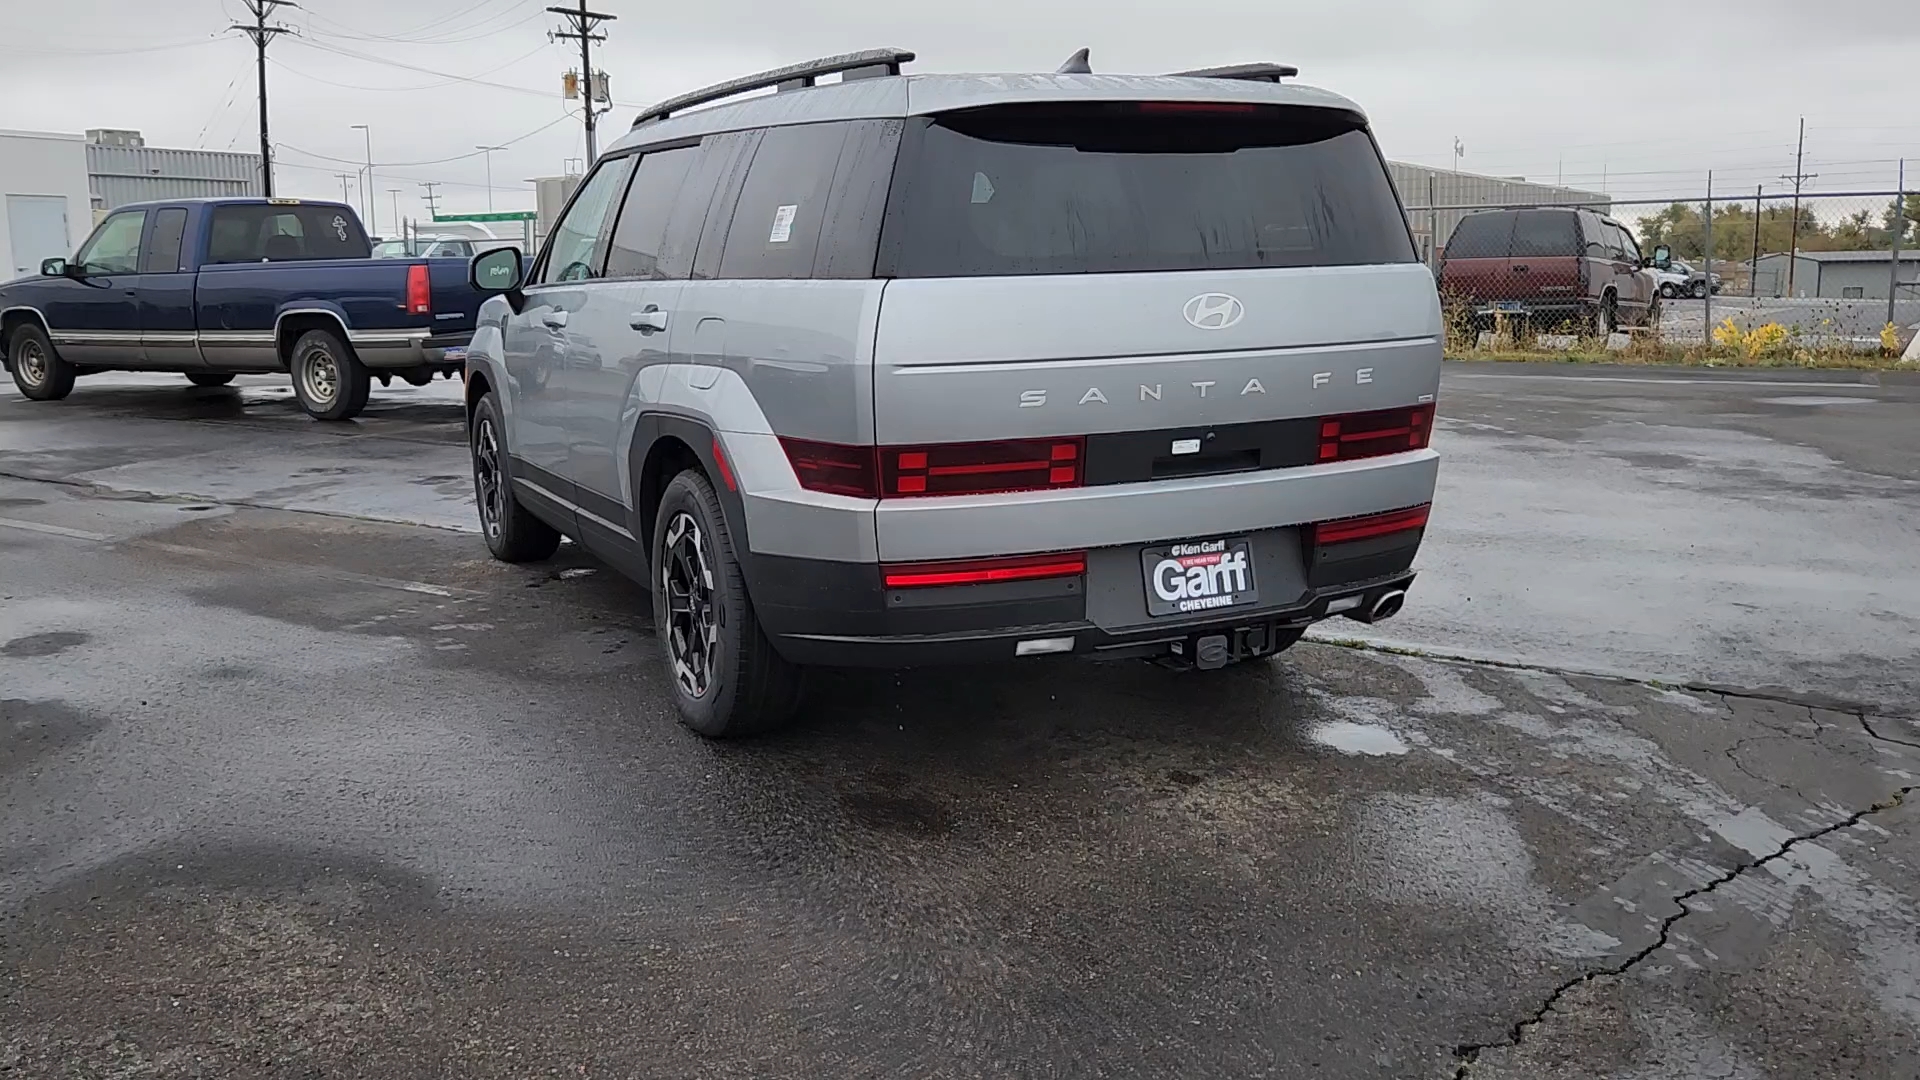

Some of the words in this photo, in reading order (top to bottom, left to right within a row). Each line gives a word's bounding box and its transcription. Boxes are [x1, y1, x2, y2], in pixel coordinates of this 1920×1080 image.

[1019, 379, 1267, 408] SANTA
[1312, 367, 1374, 389] FE
[1180, 543, 1200, 556] Ken
[1201, 540, 1225, 553] Garff
[1153, 551, 1247, 601] Garff
[1179, 595, 1233, 611] CHEYENNE
